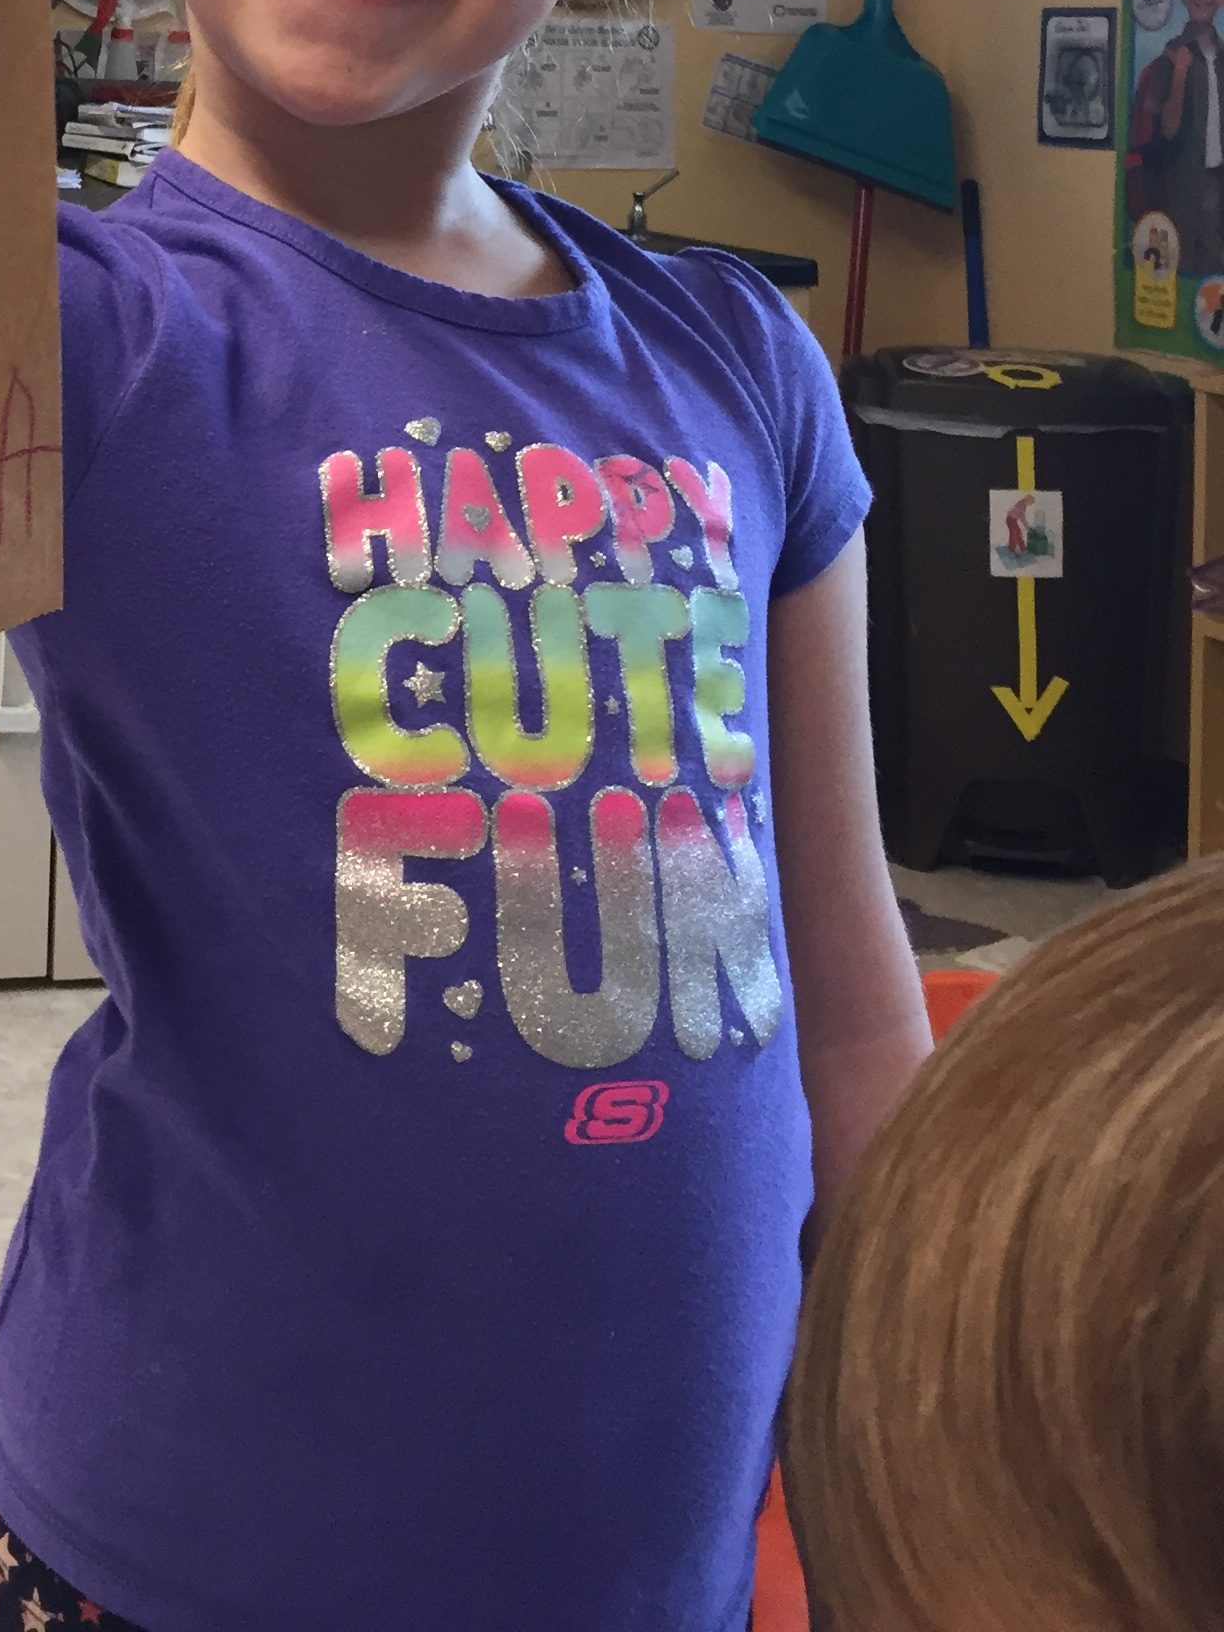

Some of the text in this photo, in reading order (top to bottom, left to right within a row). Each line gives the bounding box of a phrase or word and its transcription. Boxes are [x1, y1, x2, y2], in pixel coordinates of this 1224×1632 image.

[319, 442, 738, 594] HAPPY
[330, 581, 757, 792] CUTE
[334, 784, 783, 1069] FUN
